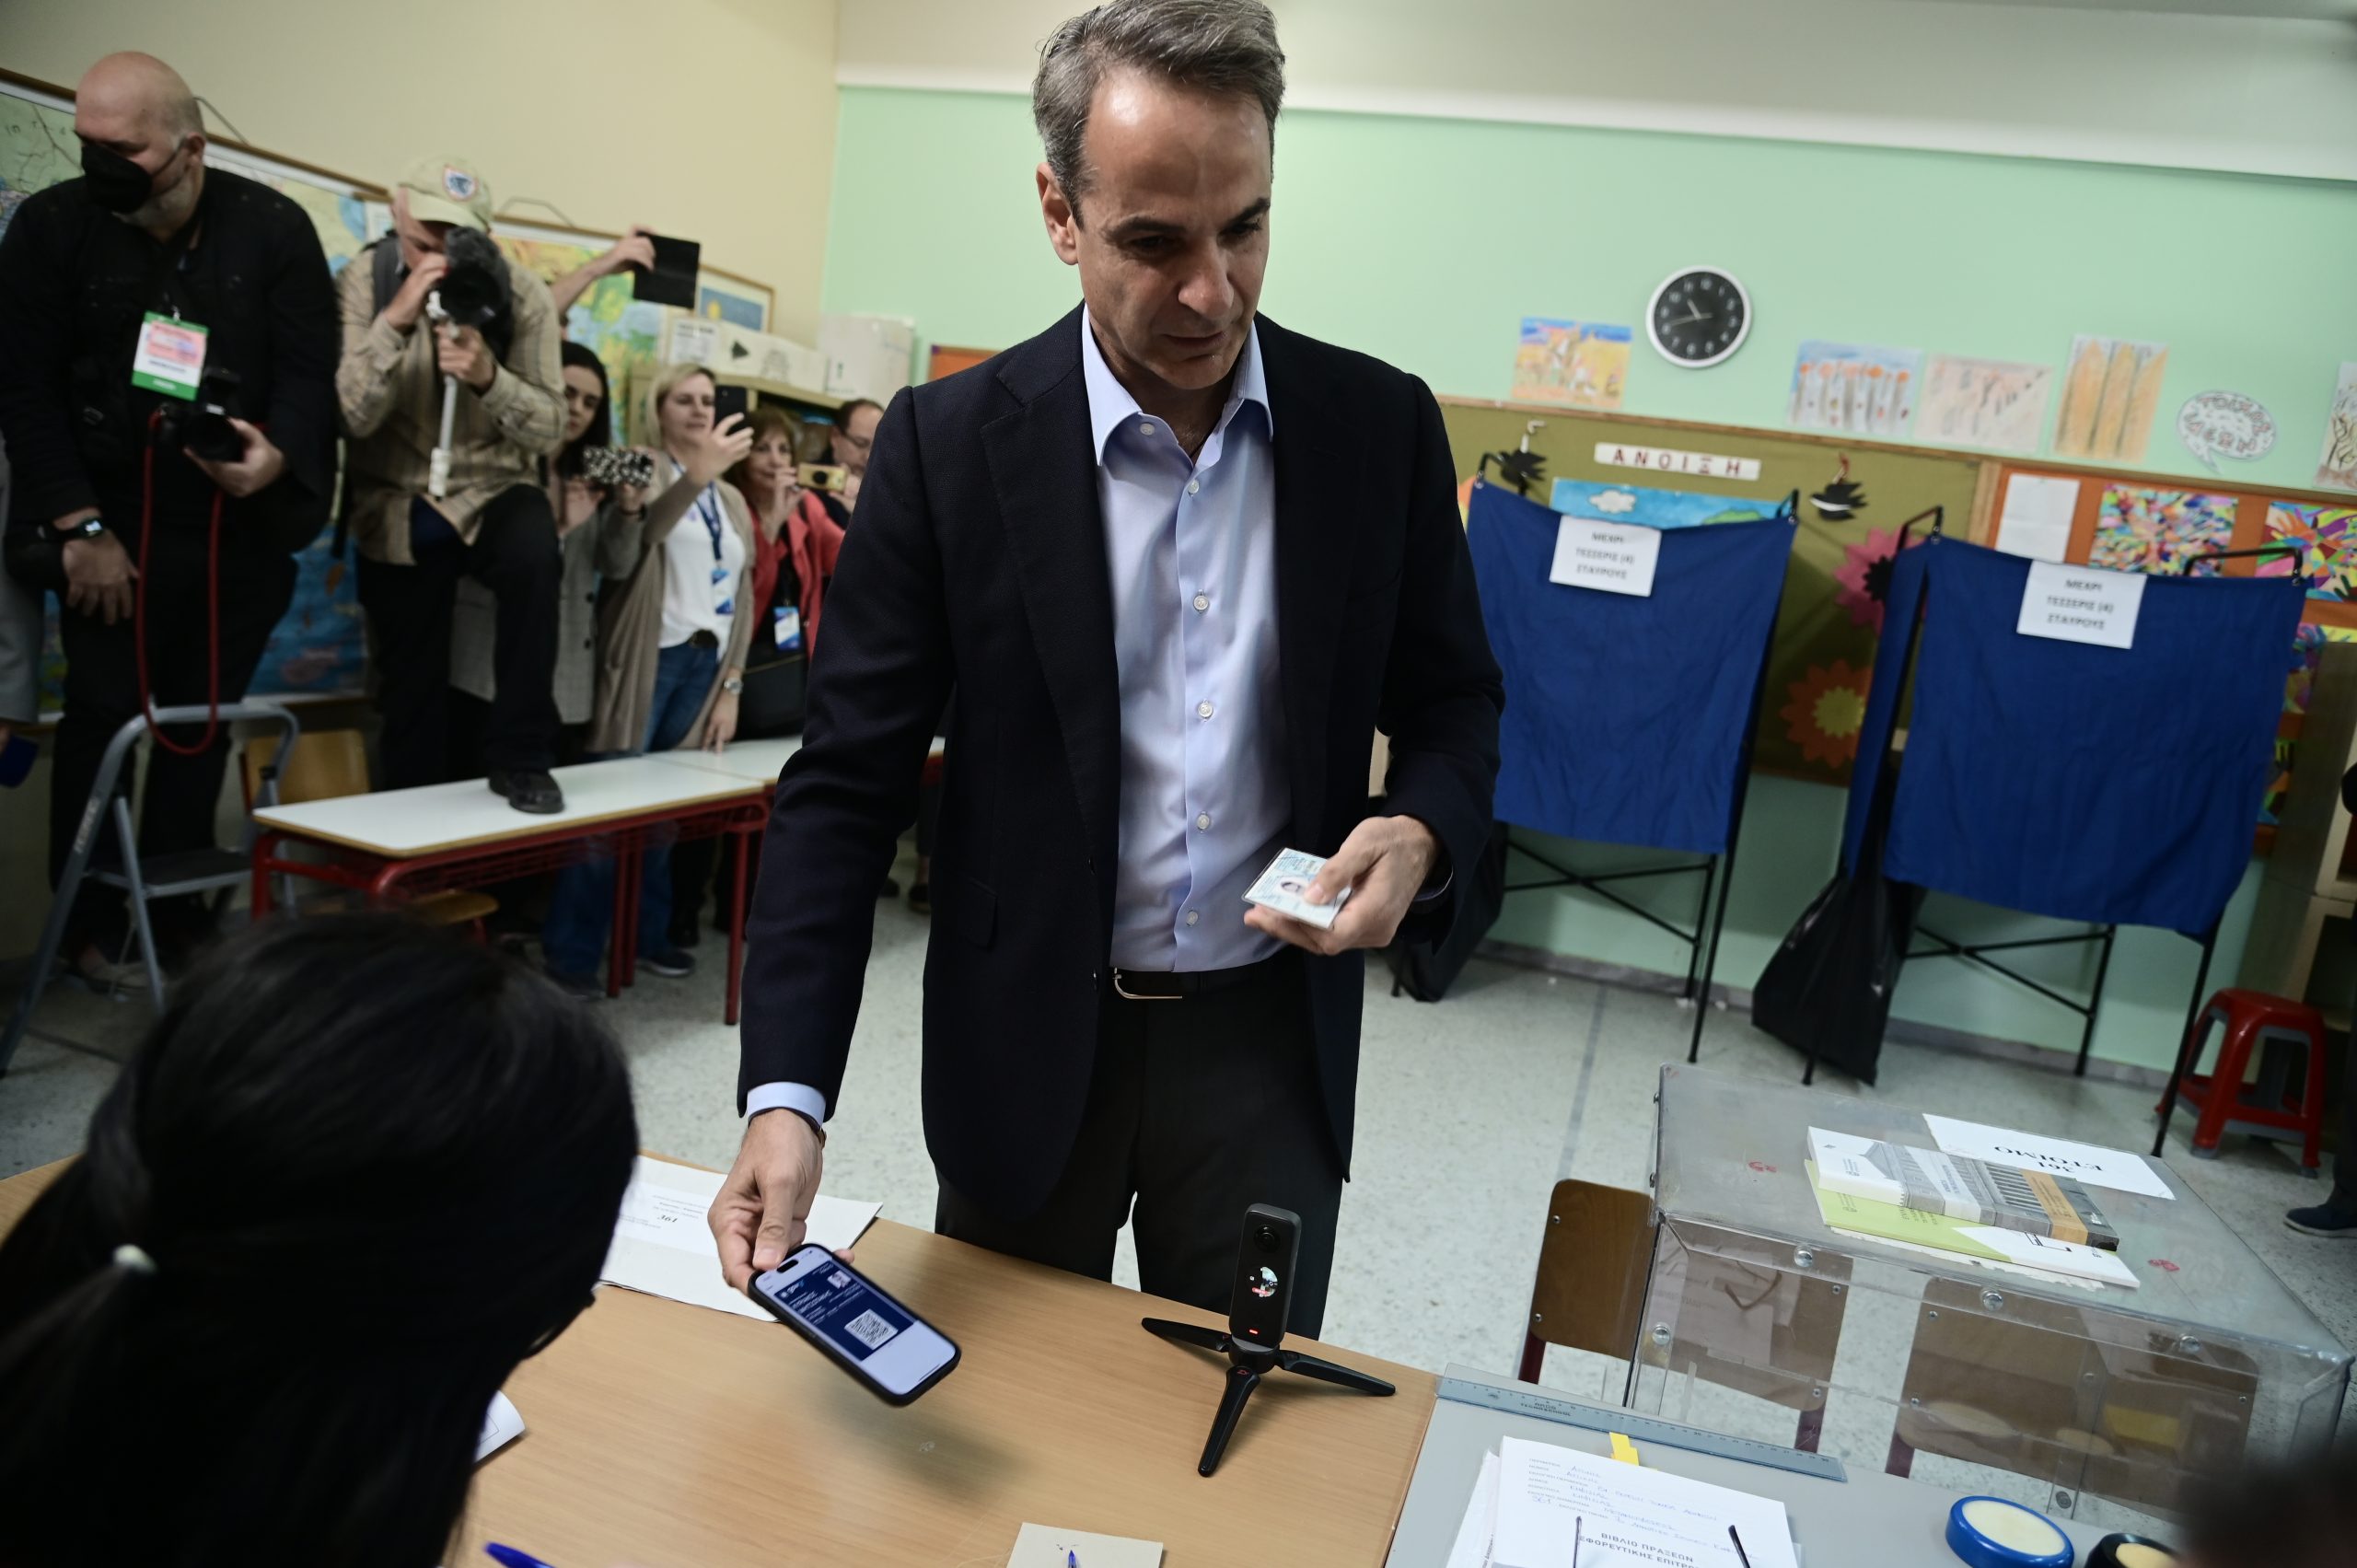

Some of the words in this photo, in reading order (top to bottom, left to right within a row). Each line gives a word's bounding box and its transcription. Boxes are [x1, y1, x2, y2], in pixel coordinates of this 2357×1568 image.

[1612, 447, 1740, 478] ΑΝΟΙΞΗ
[1994, 1146, 2103, 1171] ΕΤΟΙΜΟ
[1579, 1535, 1655, 1561] ΕΦΟΡΕΥΤΙΚΗΣ
[1656, 1556, 1701, 1568] ΕΠΙΤΡΟ
[1601, 1532, 1638, 1548] ΒΙΒΛΙΟ
[1642, 1543, 1693, 1562] ΠΡΑΞΕΩΝ
